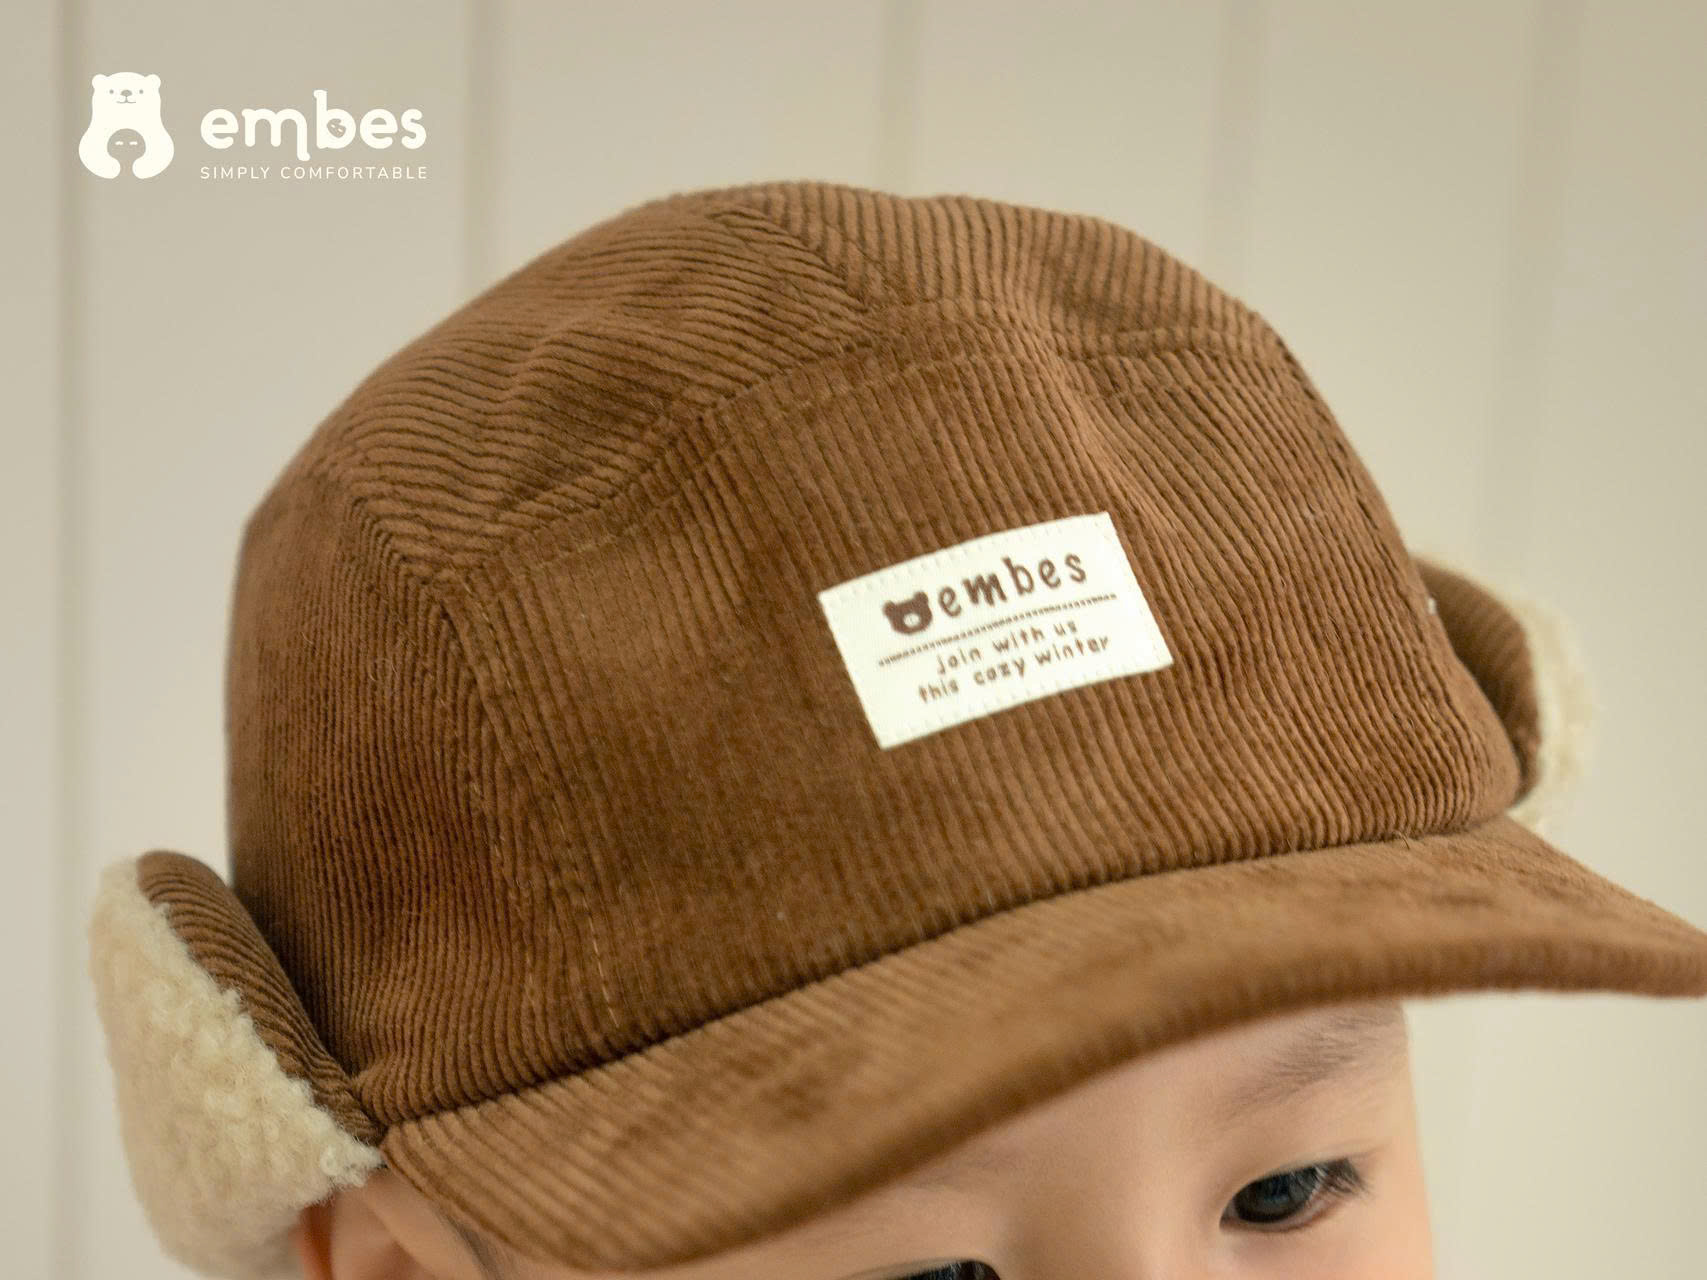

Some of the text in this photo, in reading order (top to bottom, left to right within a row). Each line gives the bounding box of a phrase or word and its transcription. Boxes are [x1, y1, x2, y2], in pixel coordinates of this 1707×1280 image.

[939, 553, 1086, 617] embes
[918, 635, 1110, 702] this cozy winter
[936, 620, 1077, 675] join with us
